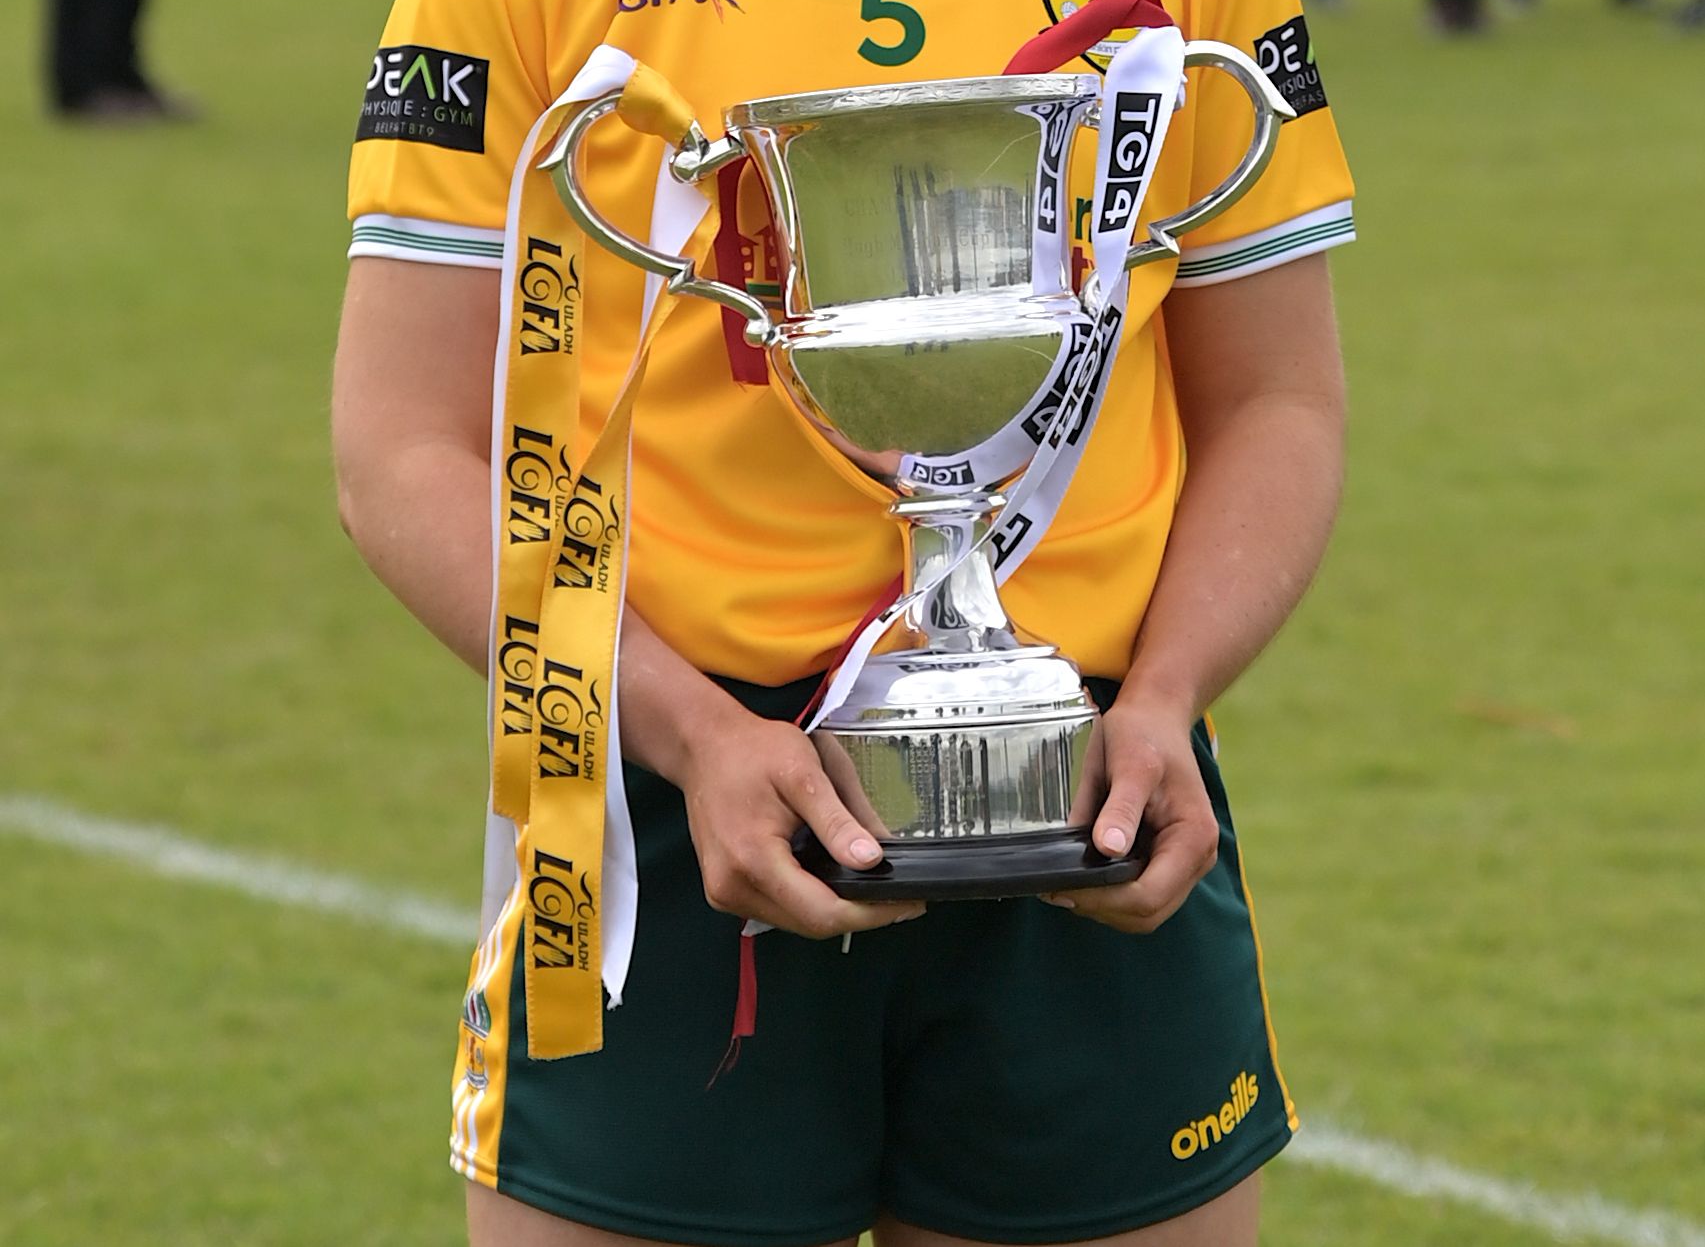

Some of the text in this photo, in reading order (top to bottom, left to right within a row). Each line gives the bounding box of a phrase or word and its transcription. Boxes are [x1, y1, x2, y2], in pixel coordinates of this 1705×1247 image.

[433, 106, 473, 127] GYM
[1103, 97, 1158, 226] TG4
[563, 305, 574, 355] ULADH
[596, 543, 612, 594] ULADH
[583, 730, 596, 781] ULADH
[577, 922, 589, 972] ULADH
[1171, 1071, 1259, 1160] o'neills
